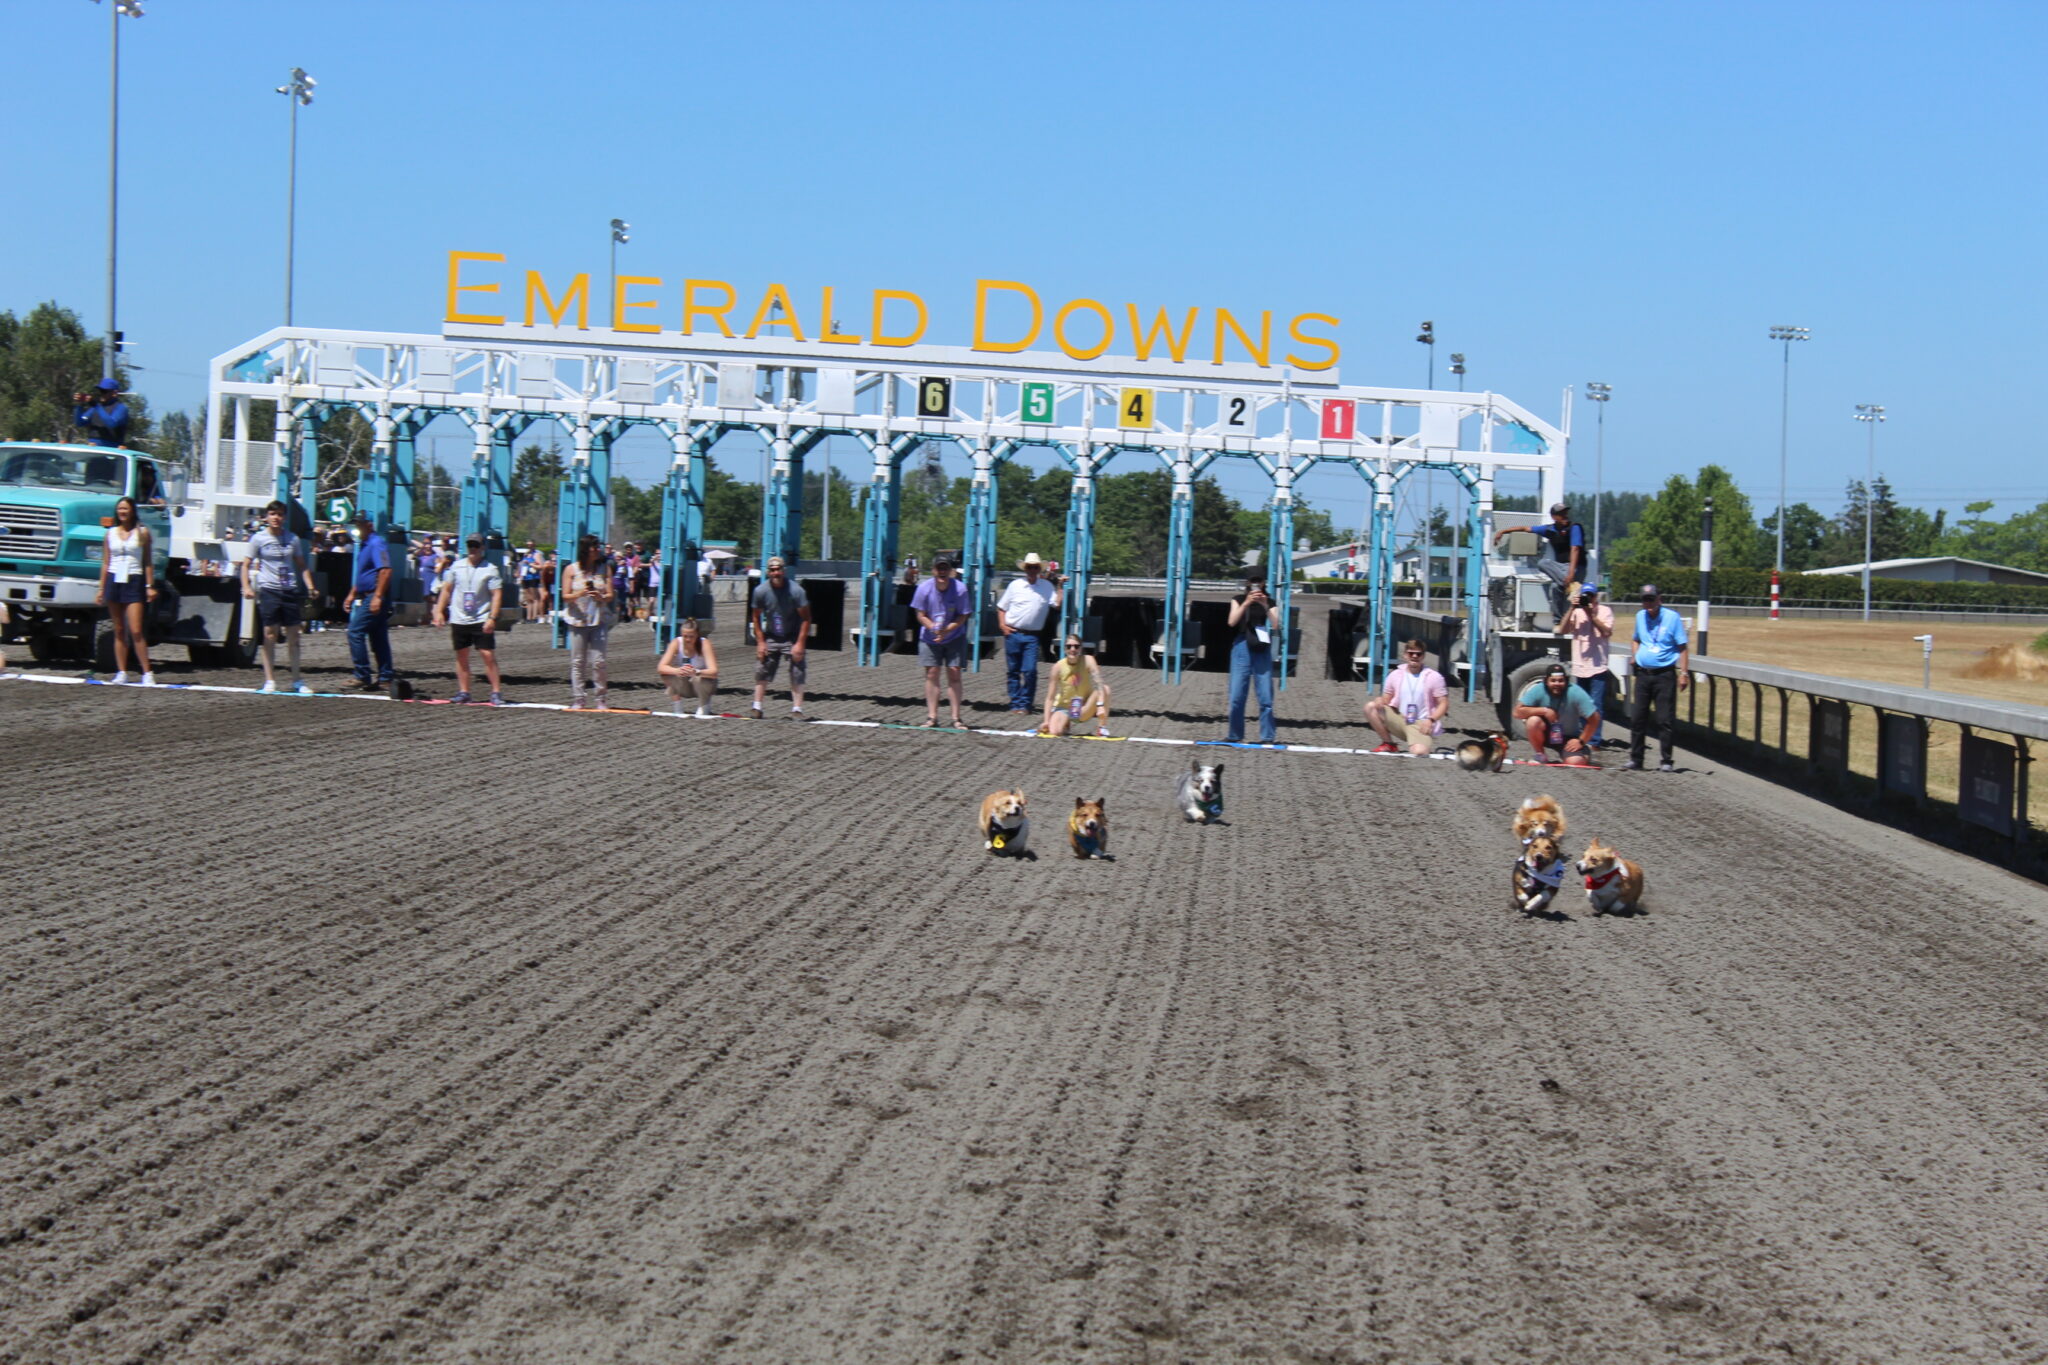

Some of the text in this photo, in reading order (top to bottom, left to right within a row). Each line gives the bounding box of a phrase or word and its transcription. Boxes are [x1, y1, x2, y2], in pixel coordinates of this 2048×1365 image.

[445, 250, 1341, 371] EMERALD DOWNS
[925, 382, 944, 412] 6
[1029, 388, 1047, 417] 5
[1127, 394, 1144, 423] 4
[1229, 397, 1246, 426] 2
[1332, 406, 1343, 434] 1
[330, 499, 348, 522] 5
